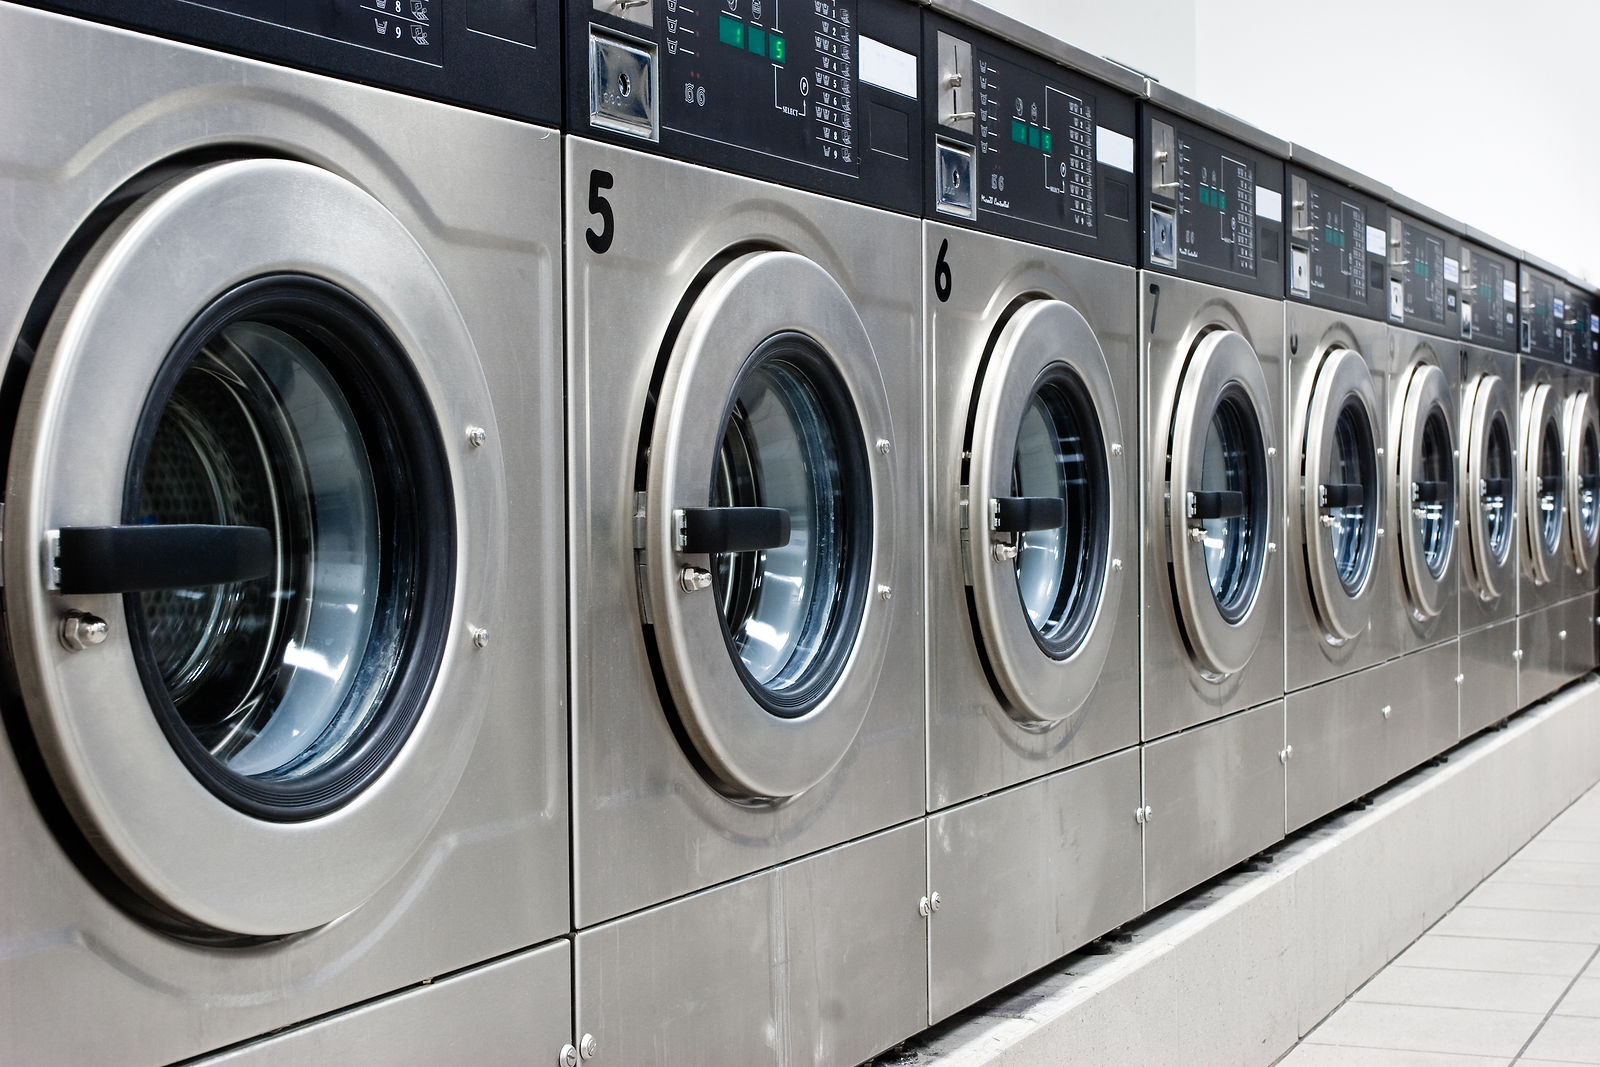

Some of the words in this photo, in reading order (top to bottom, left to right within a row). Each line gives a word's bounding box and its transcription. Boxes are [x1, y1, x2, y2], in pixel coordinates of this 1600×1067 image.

[395, 0, 401, 12] 8
[395, 26, 401, 39] 9
[776, 40, 782, 58] 5
[782, 105, 799, 117] SELECT
[1045, 134, 1050, 149] 5
[585, 168, 615, 254] 5
[934, 237, 952, 303] 6
[1149, 283, 1160, 335] 7
